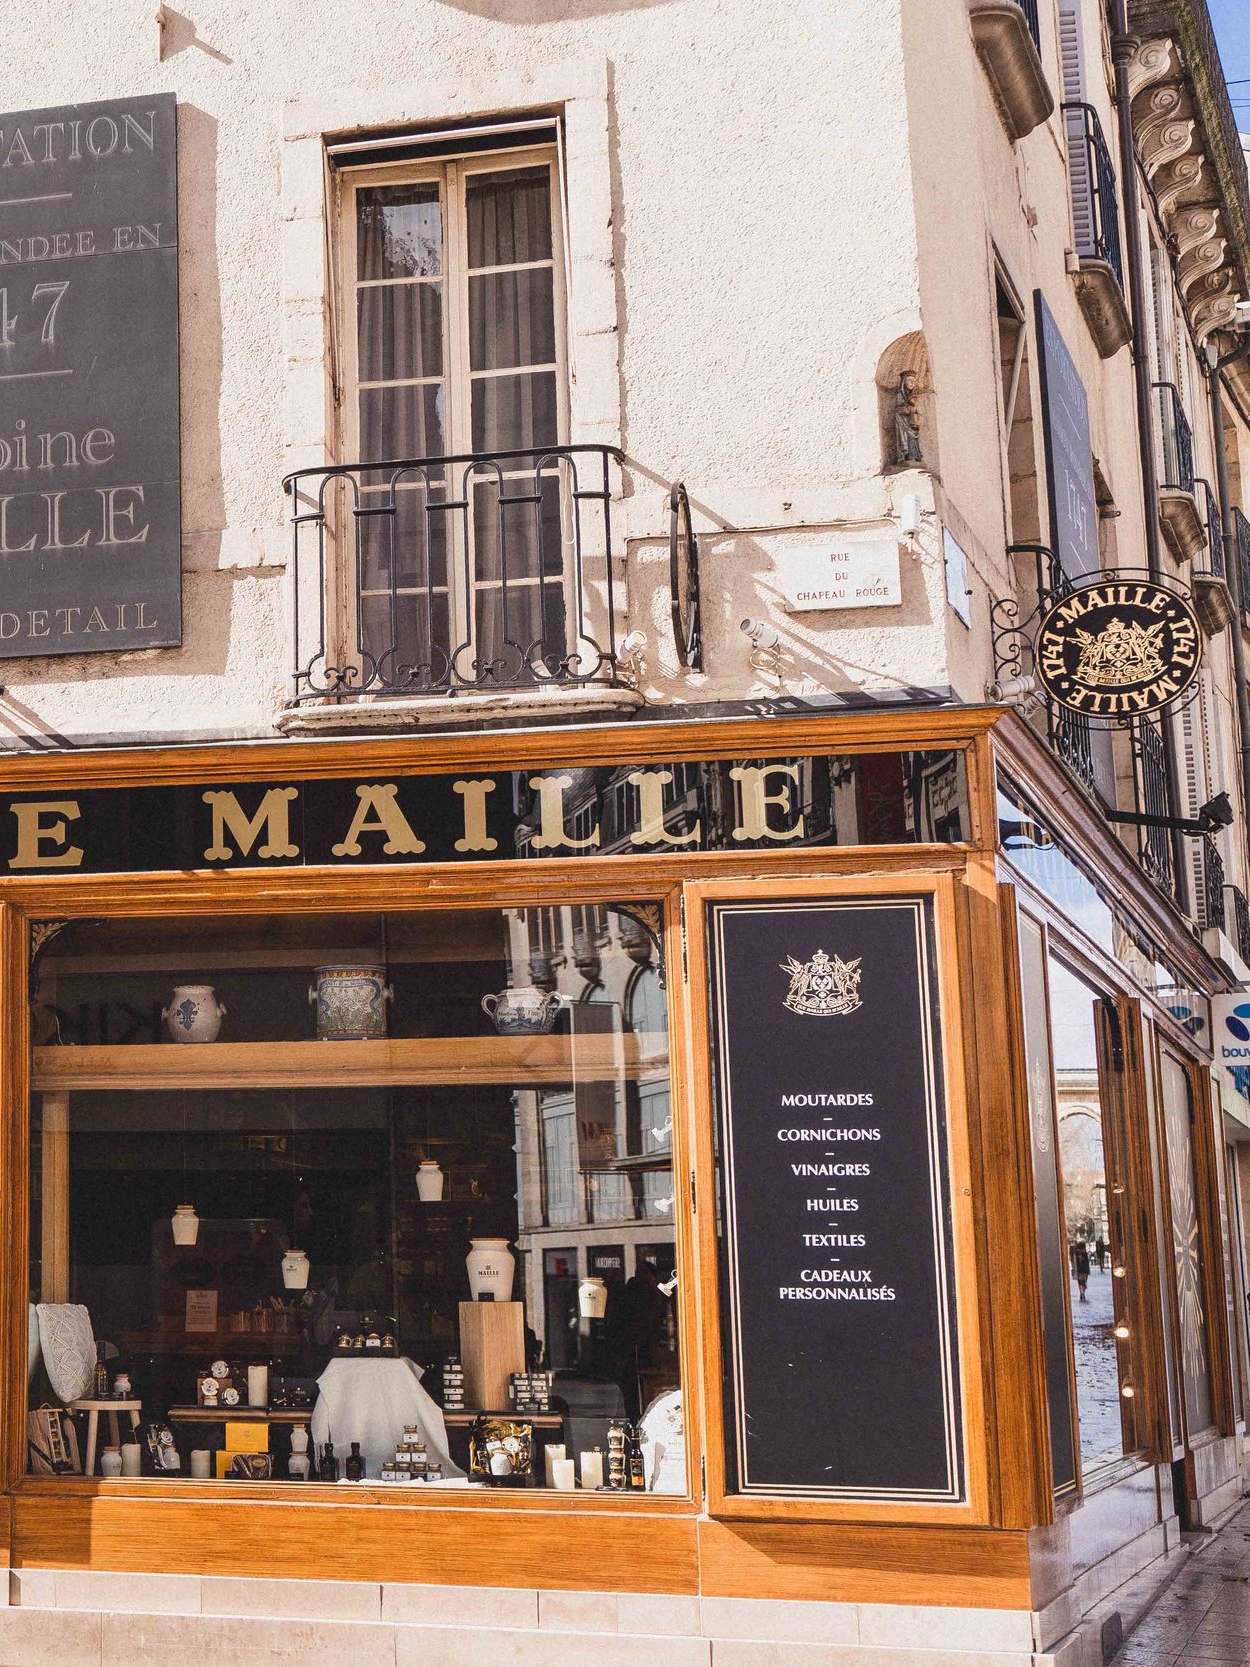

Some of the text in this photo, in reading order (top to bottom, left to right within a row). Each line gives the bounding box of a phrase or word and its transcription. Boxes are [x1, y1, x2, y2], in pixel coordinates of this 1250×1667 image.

[113, 223, 162, 250] EN
[830, 553, 850, 562] RUE
[835, 572, 848, 581] DU
[797, 587, 889, 601] CHAPEAU ROUGE
[1057, 586, 1171, 625] MAILLE
[1066, 674, 1181, 713] MAILLE
[202, 763, 807, 861] MAILLE
[781, 1094, 874, 1106] MOUTARDES
[777, 1129, 881, 1141] CORNICHONS
[791, 1164, 871, 1176] VINAIGRES
[806, 1199, 859, 1211] HUILES
[802, 1234, 866, 1246] TEXTILES
[800, 1269, 872, 1282] CADEAUX
[779, 1285, 896, 1301] PERSONNALISÉS
